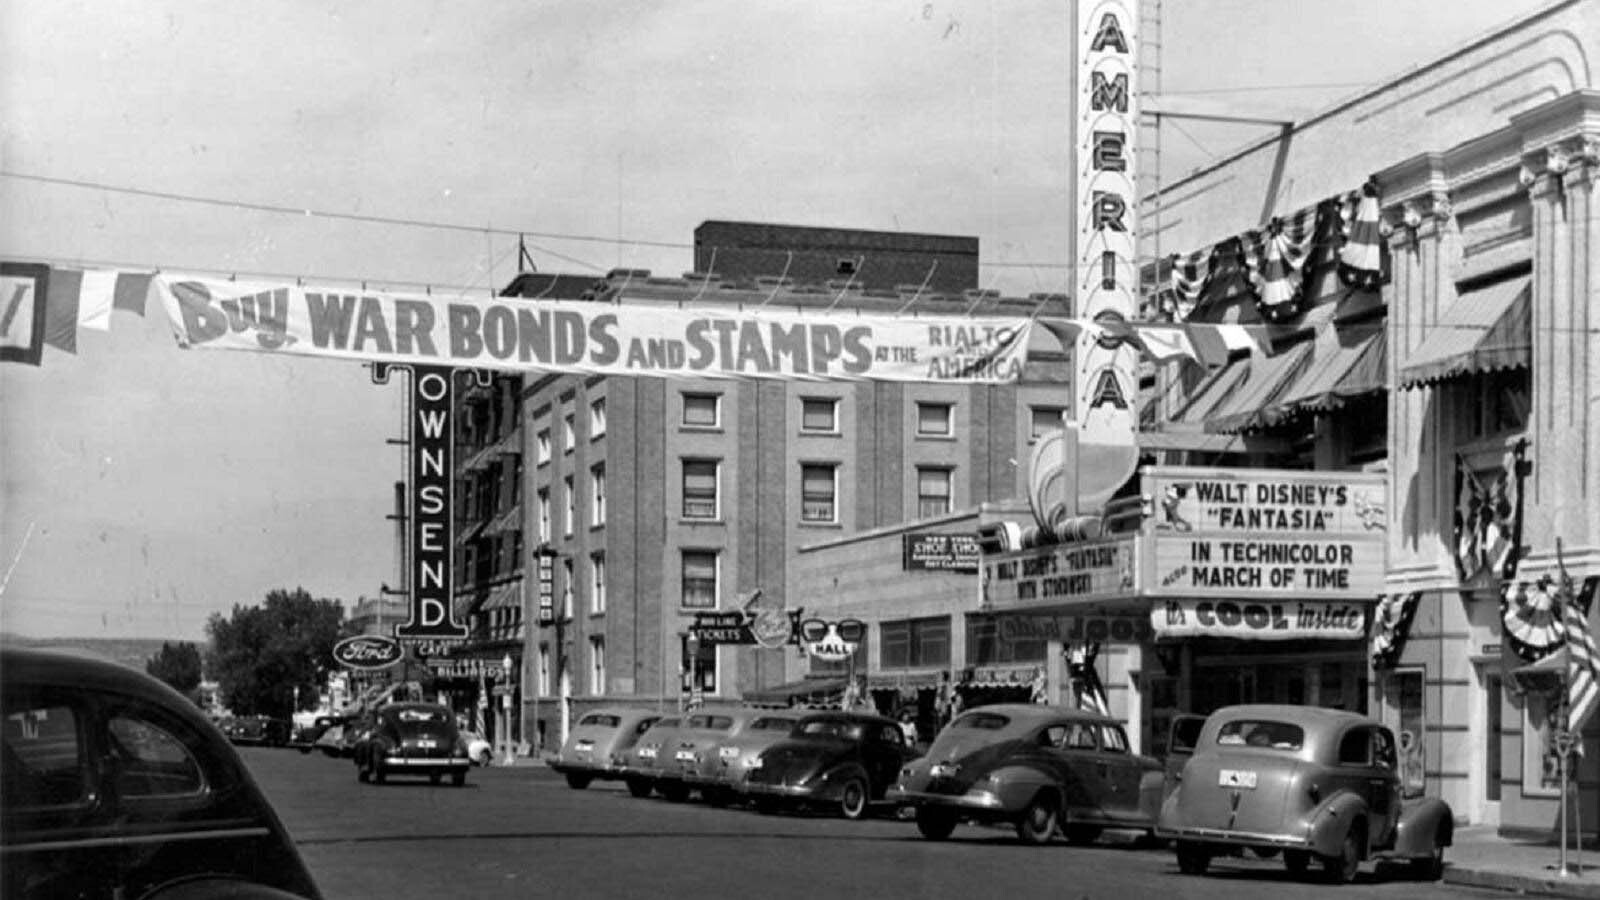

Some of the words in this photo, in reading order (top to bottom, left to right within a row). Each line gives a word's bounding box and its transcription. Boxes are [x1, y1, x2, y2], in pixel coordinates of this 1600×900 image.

[1090, 12, 1128, 410] AMERICA
[170, 281, 298, 349] Buy
[304, 292, 439, 357] WAR
[448, 303, 619, 366] BONDS
[626, 338, 686, 369] AND
[686, 319, 872, 373] STAMPS
[875, 346, 891, 362] AT
[892, 346, 917, 363] THE
[928, 325, 1013, 349] RIALTO
[927, 356, 1023, 381] AMERICA
[418, 373, 448, 626] OWNSEND
[1196, 481, 1247, 504] WALT
[1256, 484, 1348, 506] DISNEY'S
[1207, 508, 1334, 530] "FANTASIA"
[951, 542, 979, 553] SHO
[1191, 541, 1211, 561] IN
[1220, 543, 1352, 564] TECHNICOLOR
[1192, 567, 1261, 588] MARCH
[1270, 567, 1295, 588] OF
[1303, 568, 1349, 588] TIME
[1195, 602, 1288, 630] COOL
[697, 629, 741, 641] TICKETS
[342, 641, 393, 660] Ford
[815, 644, 849, 654] HALL
